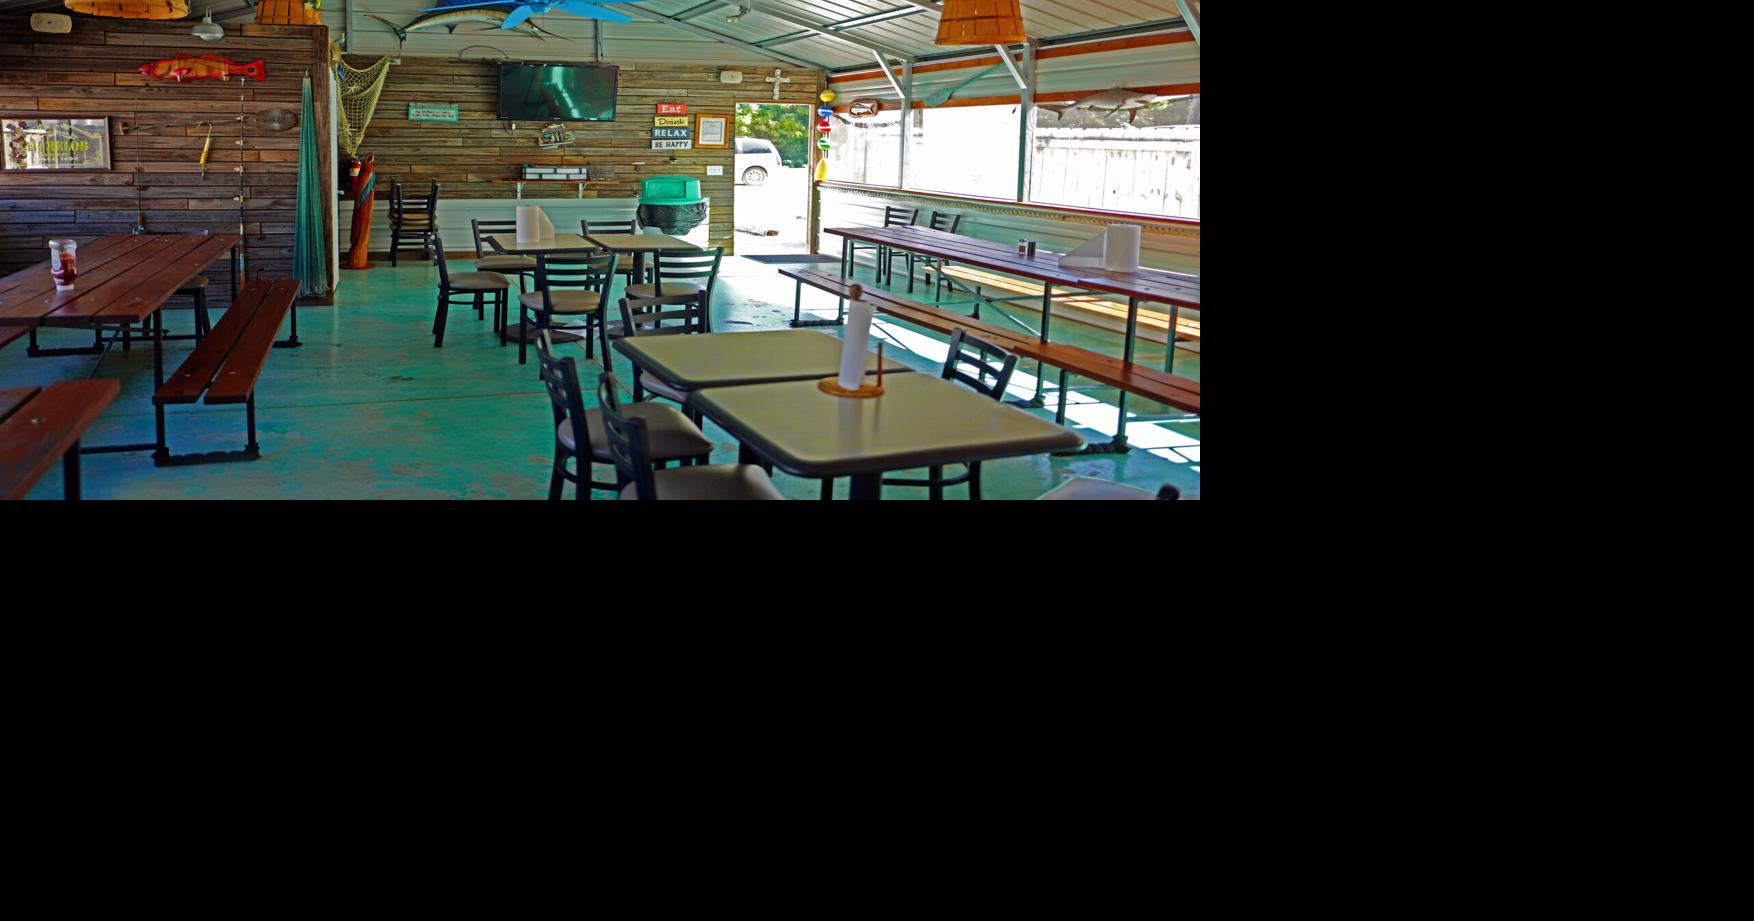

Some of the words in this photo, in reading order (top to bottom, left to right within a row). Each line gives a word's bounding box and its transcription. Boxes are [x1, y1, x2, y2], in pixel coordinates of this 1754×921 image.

[661, 104, 681, 113] Eat
[658, 118, 685, 126] Drink
[654, 129, 687, 137] RELAX
